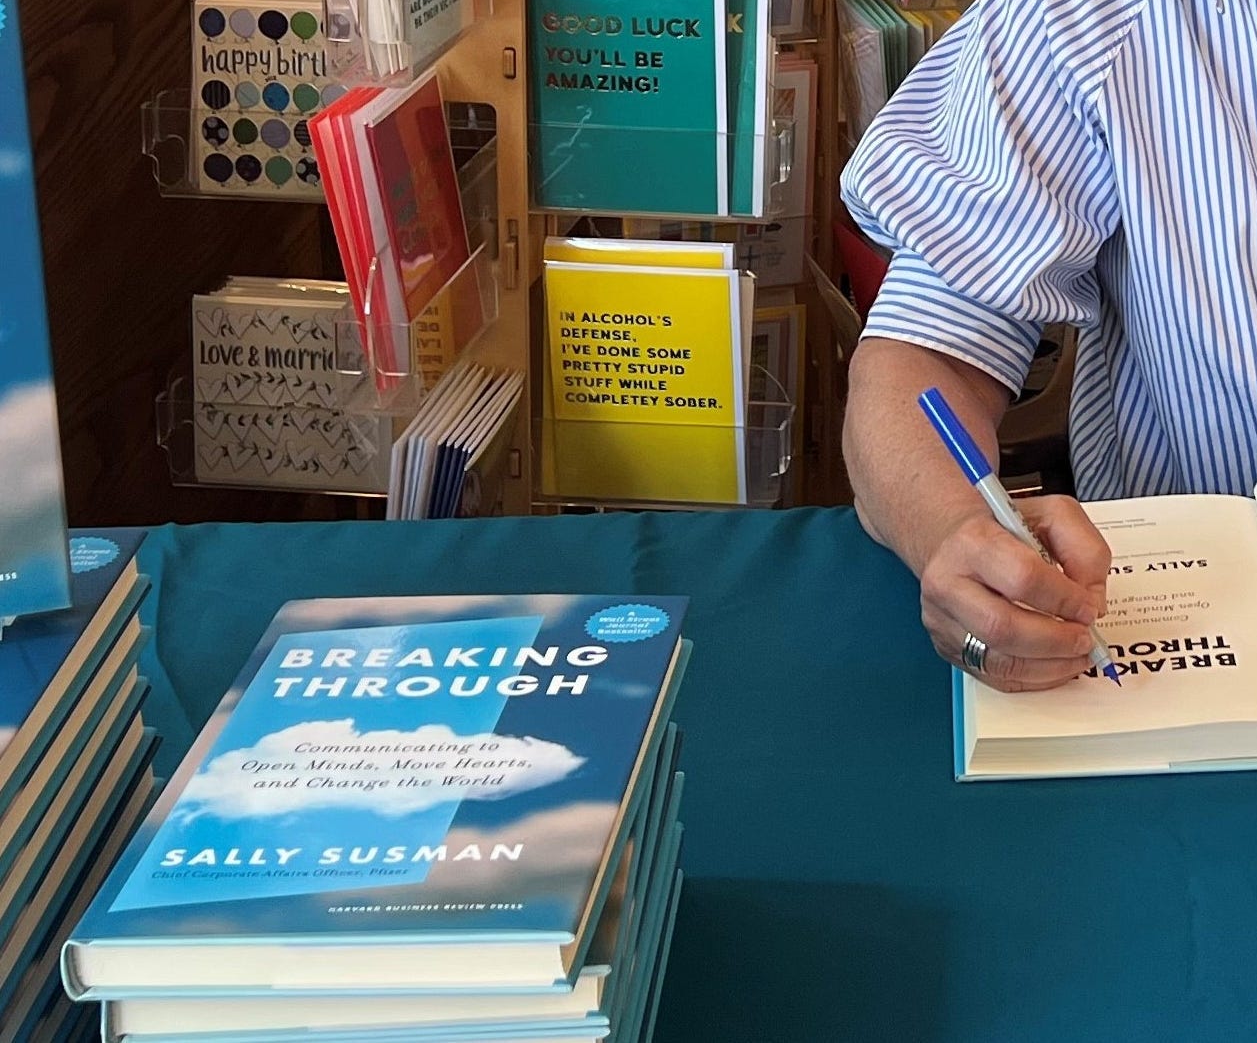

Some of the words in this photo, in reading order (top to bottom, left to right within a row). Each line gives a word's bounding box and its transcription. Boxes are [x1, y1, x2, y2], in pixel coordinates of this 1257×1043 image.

[542, 13, 622, 35] GOOD
[632, 18, 700, 39] LUCK
[202, 45, 272, 74] happy
[544, 46, 626, 68] YOU'LL
[635, 52, 663, 68] BE
[545, 73, 659, 93] AMAZING!
[560, 311, 575, 322] IN
[581, 313, 672, 326] ALCOHOL'S
[561, 327, 637, 342] DEFENSE,
[200, 340, 245, 366] Love
[248, 346, 259, 366] &
[562, 345, 591, 356] I'VE
[598, 346, 640, 357] DONE
[647, 348, 691, 359] SOME
[563, 360, 621, 372] PRETTY
[628, 364, 685, 375] STUPID
[565, 376, 613, 387] STUFF
[619, 379, 667, 390] WHILE
[565, 392, 659, 405] COMPLETEY
[665, 397, 722, 409] SOBER.
[280, 646, 609, 670] BREAKING
[272, 673, 589, 698] THROUGH
[294, 741, 469, 756] Communicating
[471, 742, 500, 752] to
[241, 759, 296, 773] Open
[305, 758, 380, 771] Minds,
[391, 759, 446, 771] Move
[453, 757, 533, 771] Hearts,
[254, 777, 298, 789] and
[306, 777, 390, 791] Change
[397, 776, 432, 788] the
[442, 775, 503, 787] World
[161, 848, 299, 866] SALLY
[319, 844, 524, 863] SUSMAN
